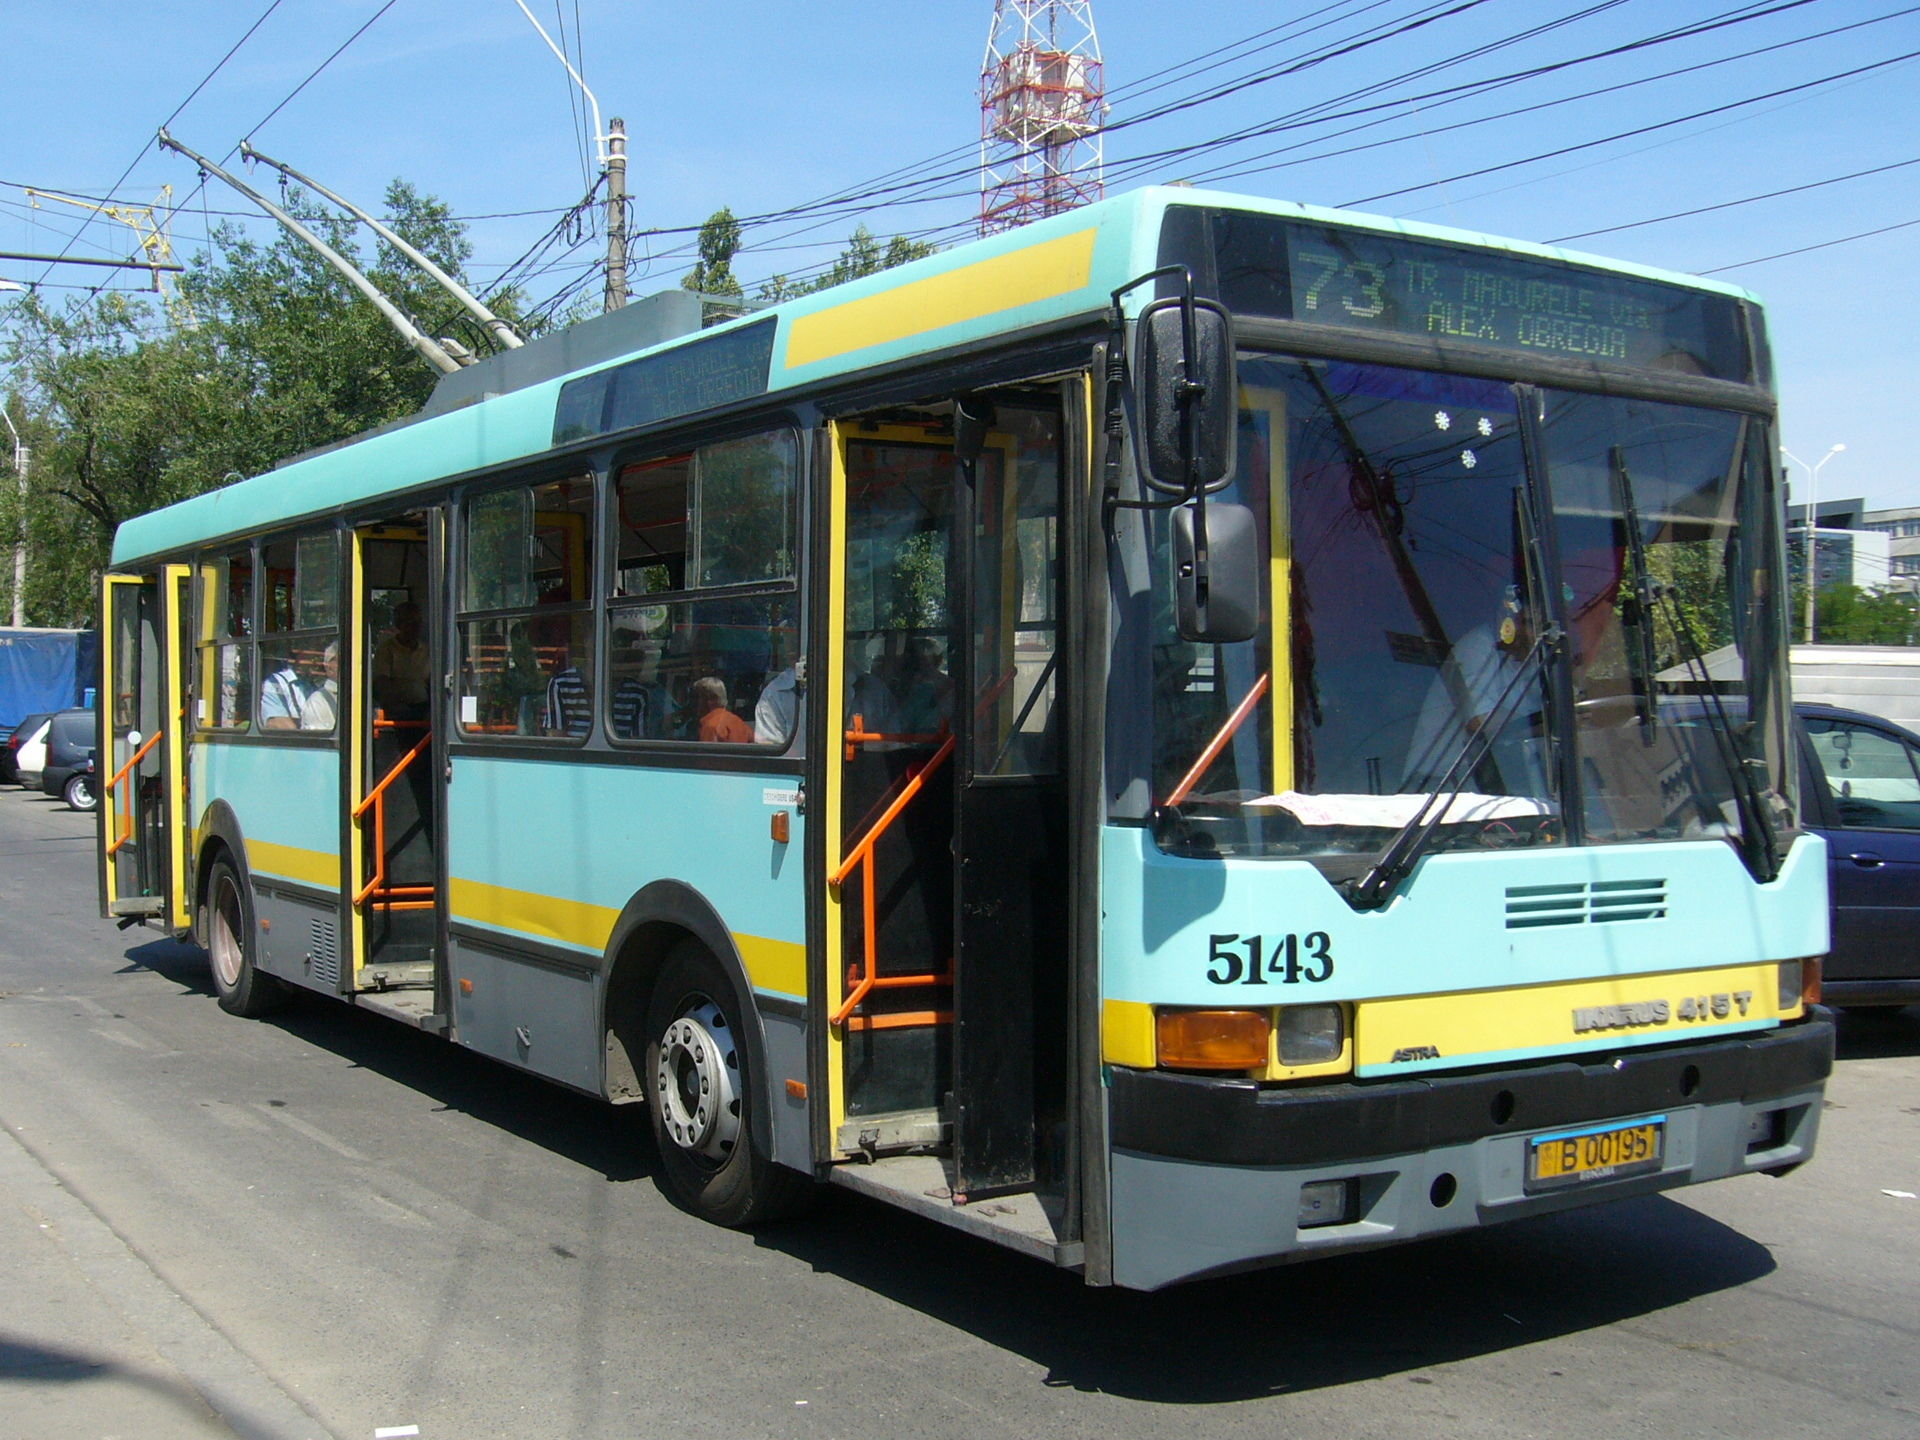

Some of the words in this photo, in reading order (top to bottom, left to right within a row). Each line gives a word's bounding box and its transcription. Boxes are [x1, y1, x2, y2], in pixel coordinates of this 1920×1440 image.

[1299, 252, 1385, 318] 73
[1404, 259, 1443, 298] TR.
[1463, 269, 1594, 321] MAGURELE
[1428, 301, 1500, 341] ALEX.
[1518, 313, 1626, 358] OBREGIA
[1206, 931, 1334, 985] 5143
[1572, 999, 1670, 1034] IKARUS
[1390, 1045, 1440, 1063] ASTRA
[1561, 1138, 1578, 1171] B
[1586, 1125, 1648, 1166] 00195
